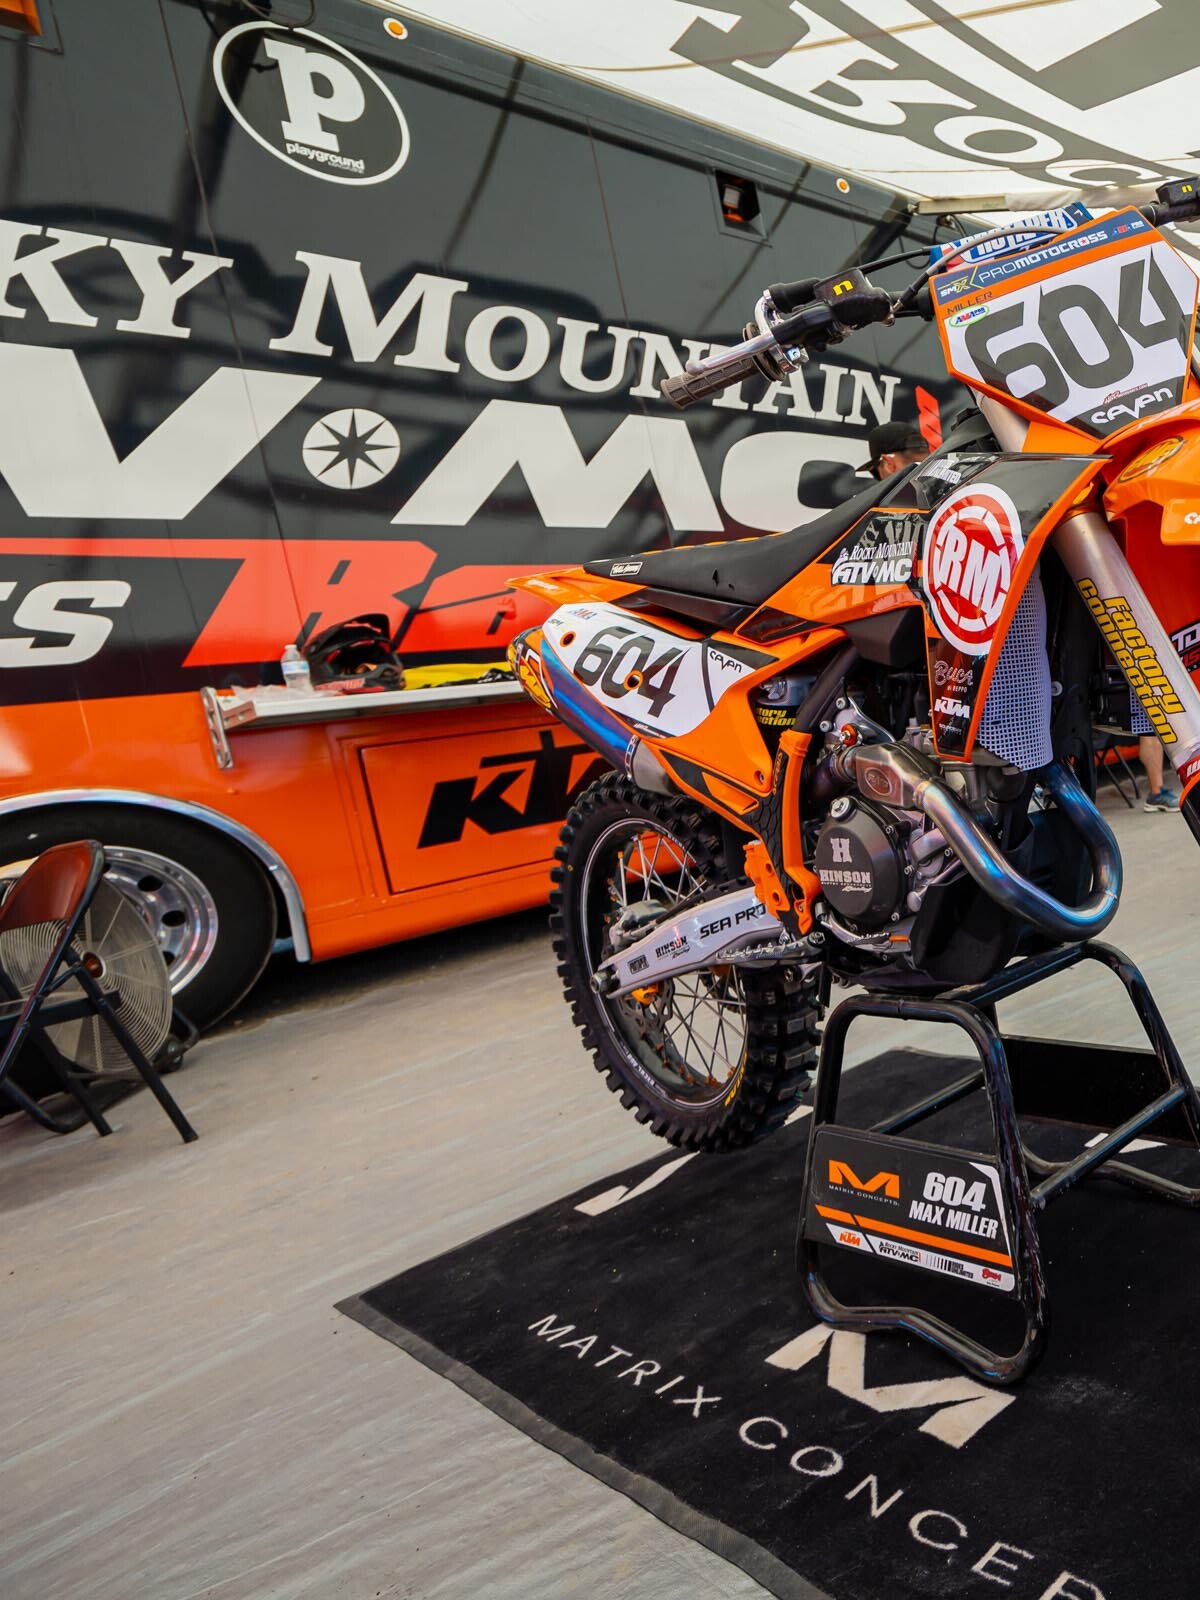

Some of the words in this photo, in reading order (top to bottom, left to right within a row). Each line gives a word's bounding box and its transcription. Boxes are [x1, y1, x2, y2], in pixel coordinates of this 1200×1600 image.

[286, 142, 365, 171] playground
[946, 291, 993, 316] MILLER
[964, 246, 1190, 414] 604
[850, 545, 877, 561] ROCKY
[875, 541, 913, 559] MOUNTAIN
[572, 625, 691, 719] 604
[757, 707, 788, 718] tory
[934, 696, 970, 719] KTM
[830, 837, 853, 863] H
[819, 869, 872, 884] HINSON
[700, 918, 732, 940] SEA
[736, 903, 766, 926] PRO
[655, 936, 689, 960] HINSON
[828, 1184, 855, 1196] MATRIX
[923, 1171, 987, 1213] 604
[909, 1200, 942, 1226] MAX
[945, 1208, 999, 1240] MILLER
[839, 1230, 861, 1247] KTM
[527, 1314, 722, 1417] MATRIX
